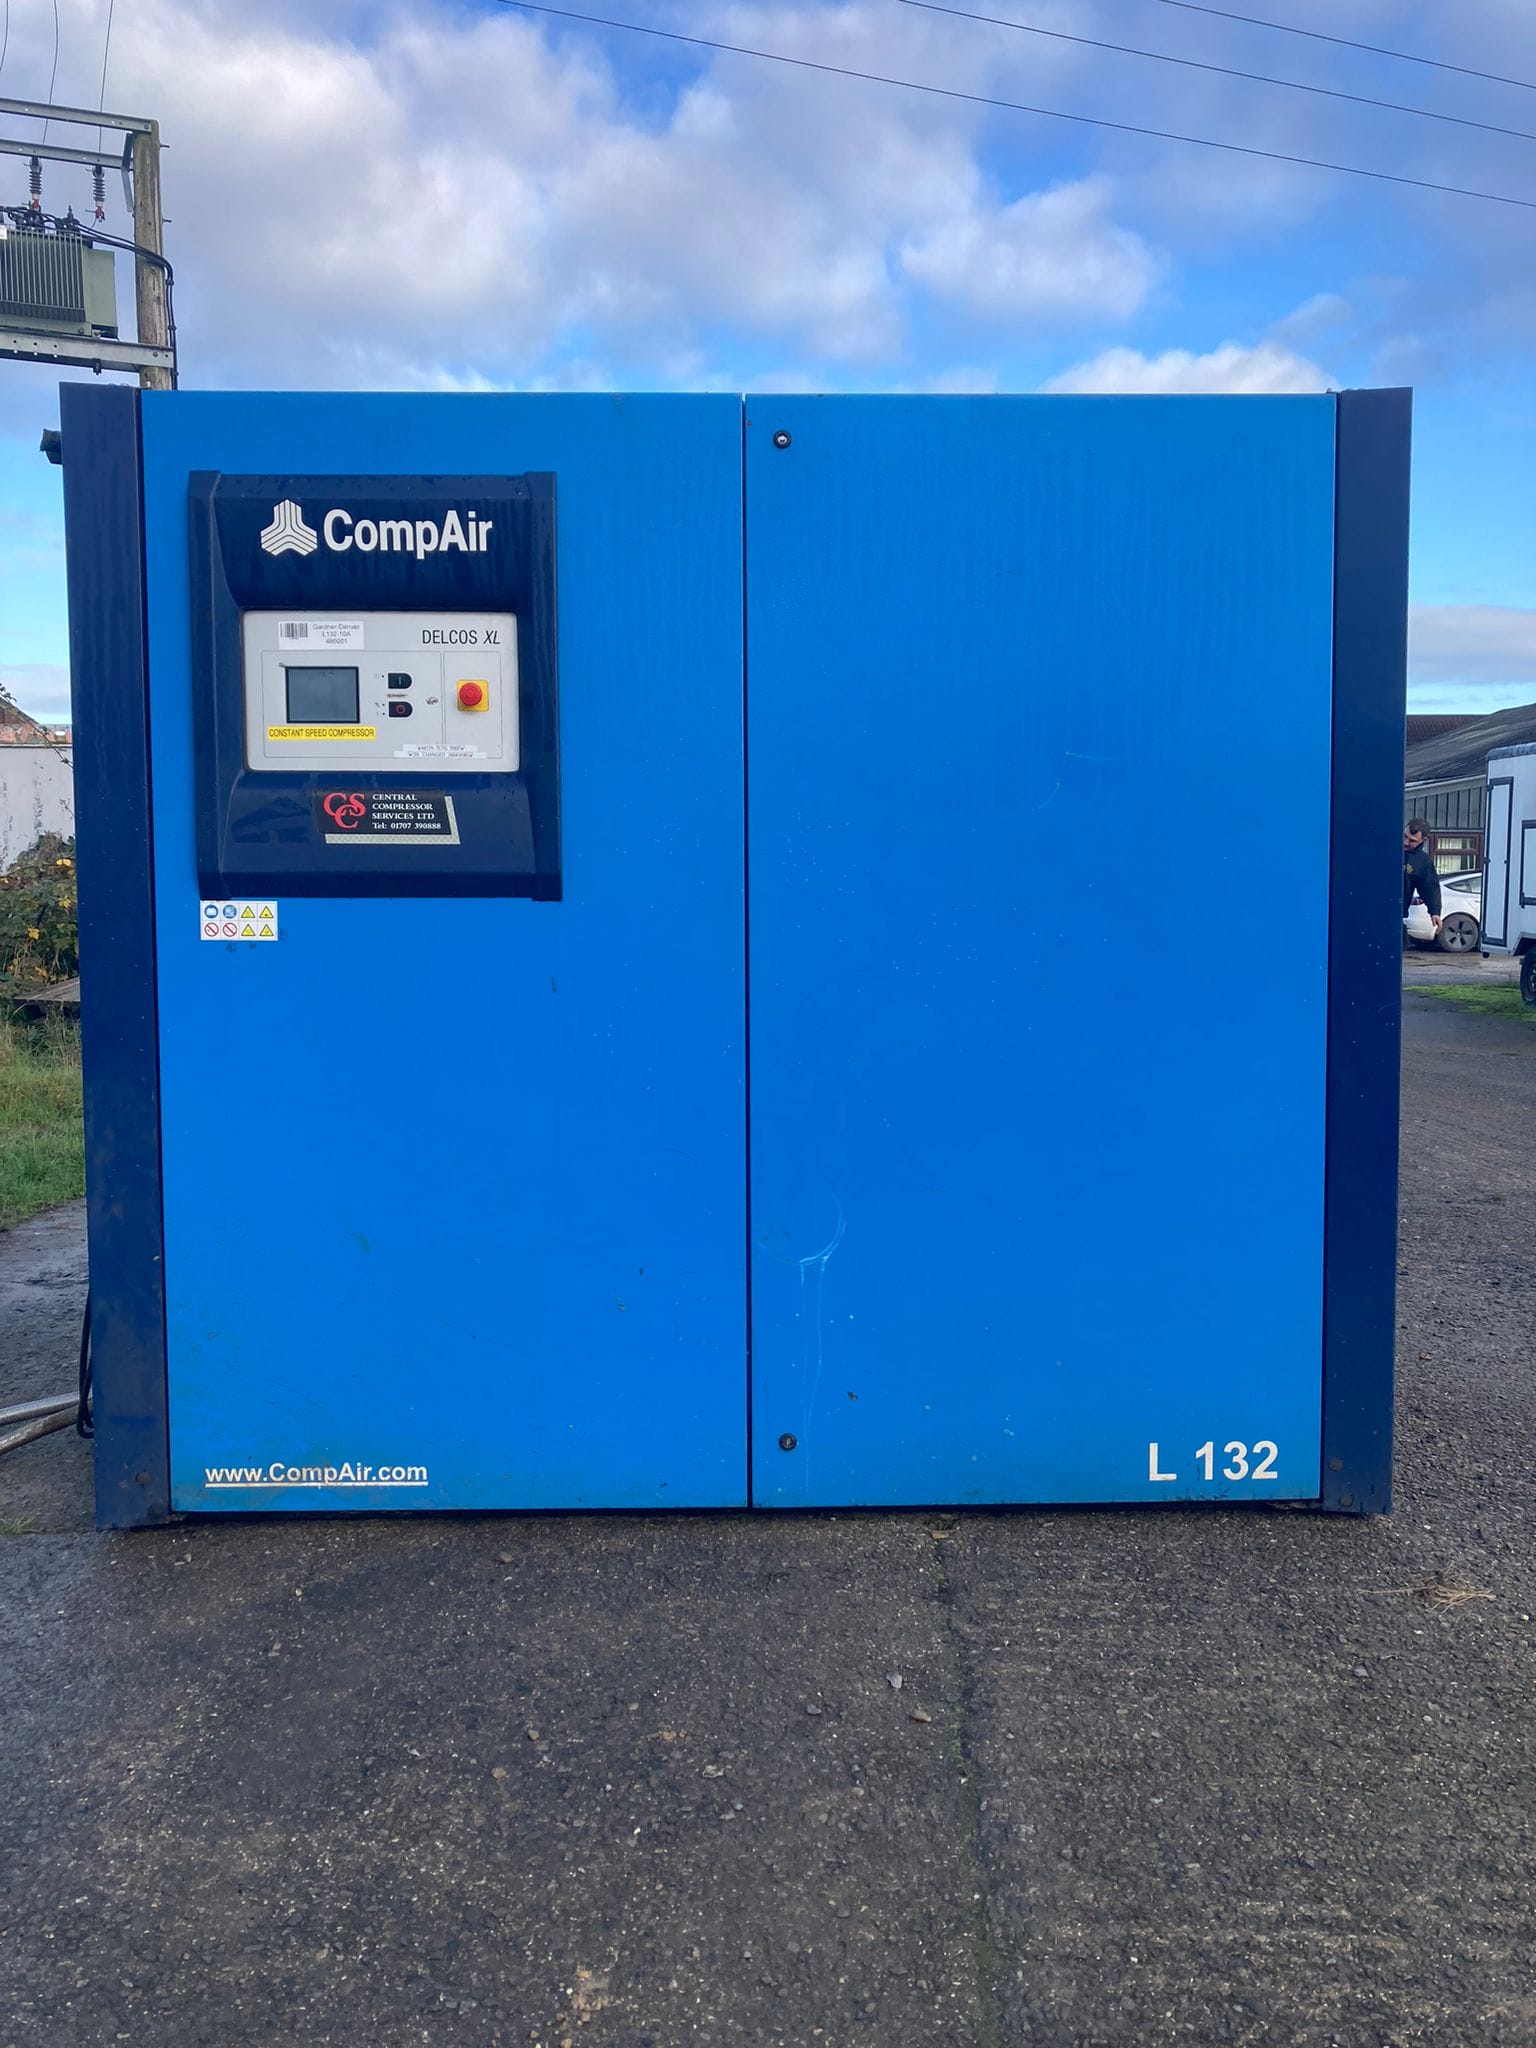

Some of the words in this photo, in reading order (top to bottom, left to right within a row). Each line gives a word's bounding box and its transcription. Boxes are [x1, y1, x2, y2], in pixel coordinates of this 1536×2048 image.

[323, 509, 493, 560] CompAir
[422, 629, 478, 645] DELCOS
[483, 630, 501, 645] XL
[269, 728, 304, 737] CONSTANT
[305, 728, 327, 737] SPEED
[328, 728, 375, 737] COMPRESSOR
[372, 793, 417, 801] CENTRAL
[372, 812, 414, 820] SERVICES
[417, 812, 435, 820] LTD
[1149, 1442, 1177, 1481] L
[1195, 1440, 1279, 1480] 132
[205, 1462, 428, 1485] www.CompAir.com
